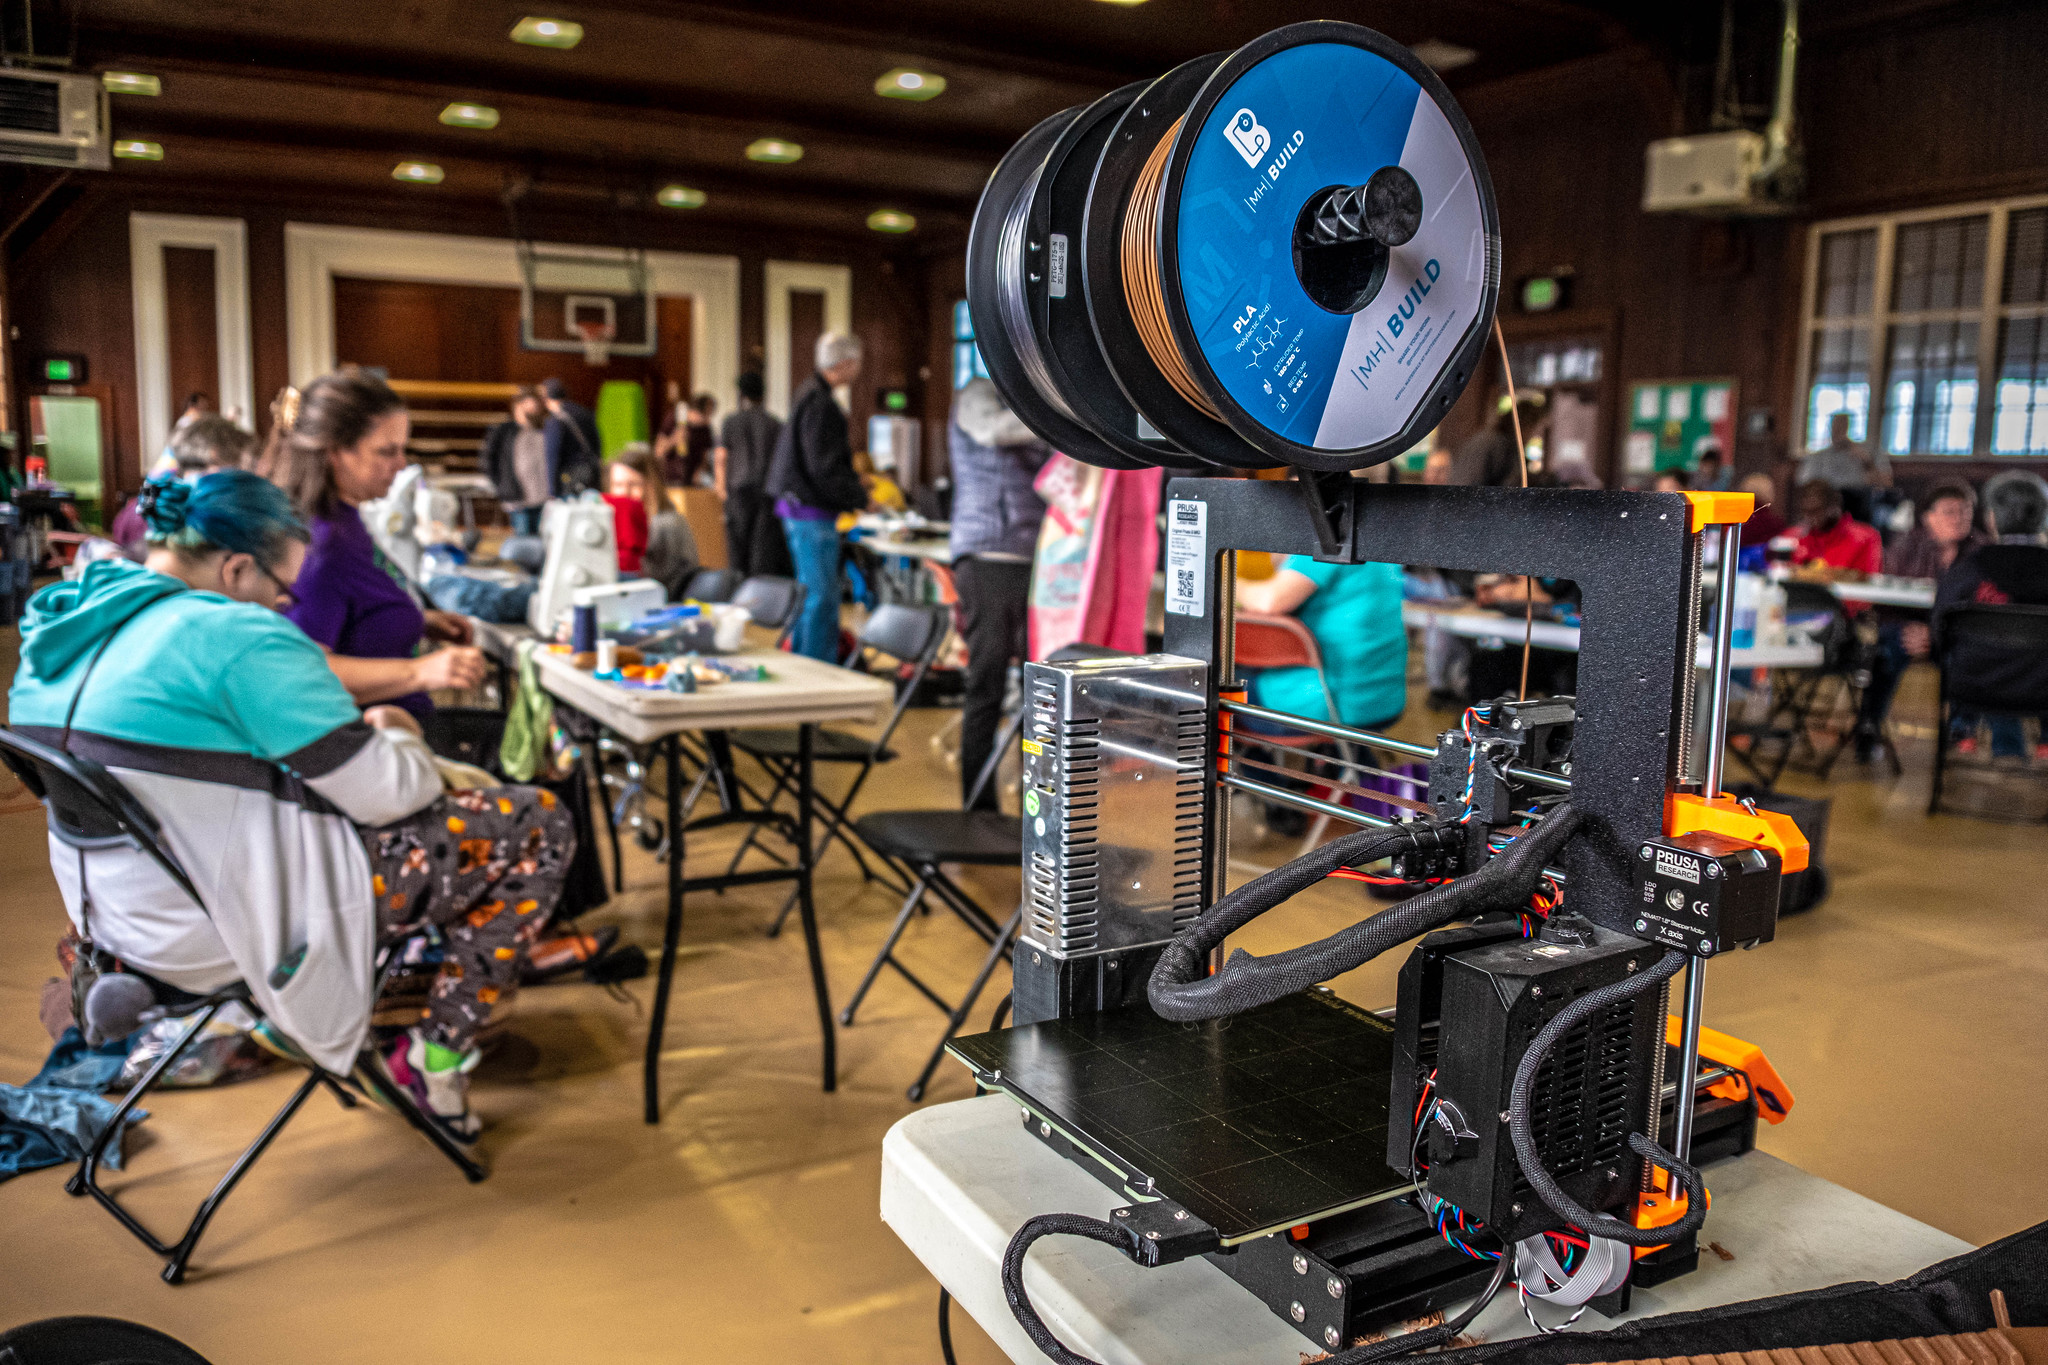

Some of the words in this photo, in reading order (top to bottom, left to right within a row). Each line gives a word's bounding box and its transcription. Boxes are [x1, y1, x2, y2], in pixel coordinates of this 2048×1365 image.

[1267, 130, 1304, 181] BUILD
[1386, 258, 1441, 339] BUILD
[1232, 304, 1257, 334] PLA
[1235, 320, 1260, 353] (Polylactic
[1258, 302, 1272, 321] Acid)
[1273, 343, 1294, 372] EXTRUDER
[1292, 328, 1304, 344] TEMP
[1398, 344, 1411, 365] SHARE
[1409, 331, 1421, 347] YOUR
[1419, 315, 1431, 333] WORK
[1277, 353, 1296, 378] 180-220
[1287, 375, 1298, 389] BED
[1295, 360, 1307, 376] TEMP
[1177, 503, 1199, 513] PRUSA
[1656, 849, 1700, 872] PRUSA
[1658, 864, 1698, 881] RESEARCH
[1660, 926, 1667, 935] X
[1667, 929, 1684, 940] axis
[1670, 919, 1690, 931] Stepper
[1690, 926, 1706, 935] Motor
